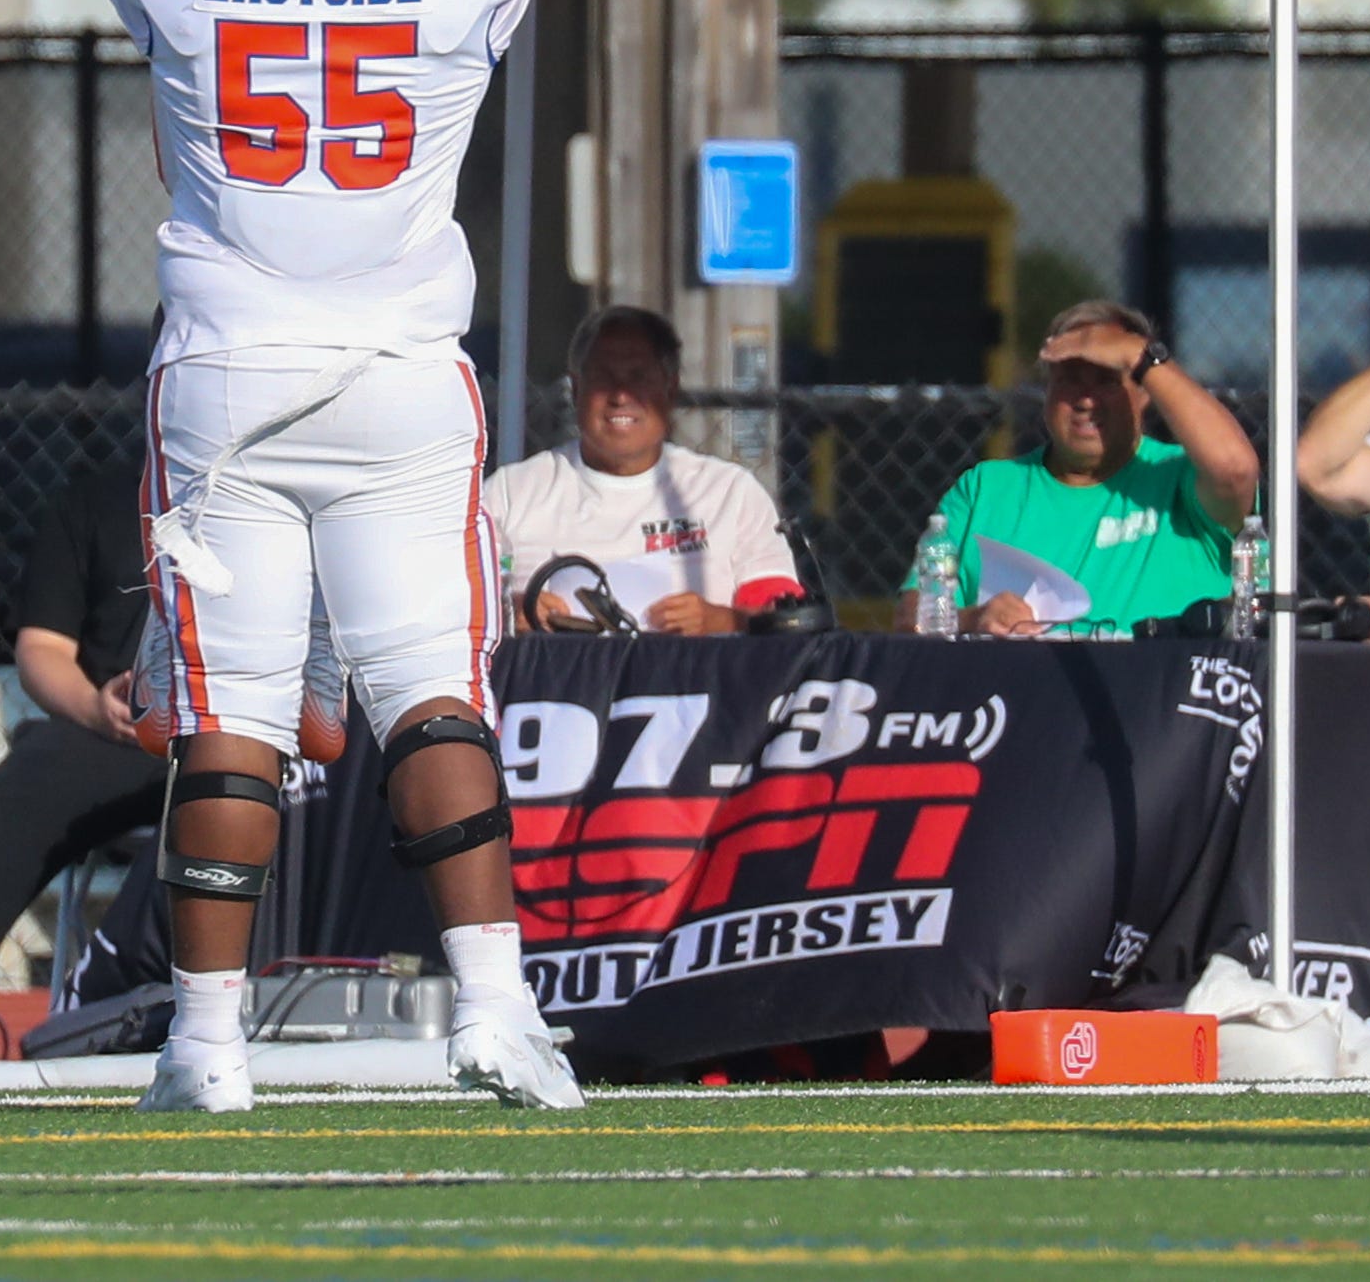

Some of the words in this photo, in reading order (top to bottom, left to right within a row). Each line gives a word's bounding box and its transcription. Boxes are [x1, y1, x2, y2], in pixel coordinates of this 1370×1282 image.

[214, 18, 420, 191] 55
[1190, 655, 1229, 674] THE
[876, 710, 963, 750] FM
[523, 940, 678, 1008] OUTH
[687, 895, 939, 973] JERSEY
